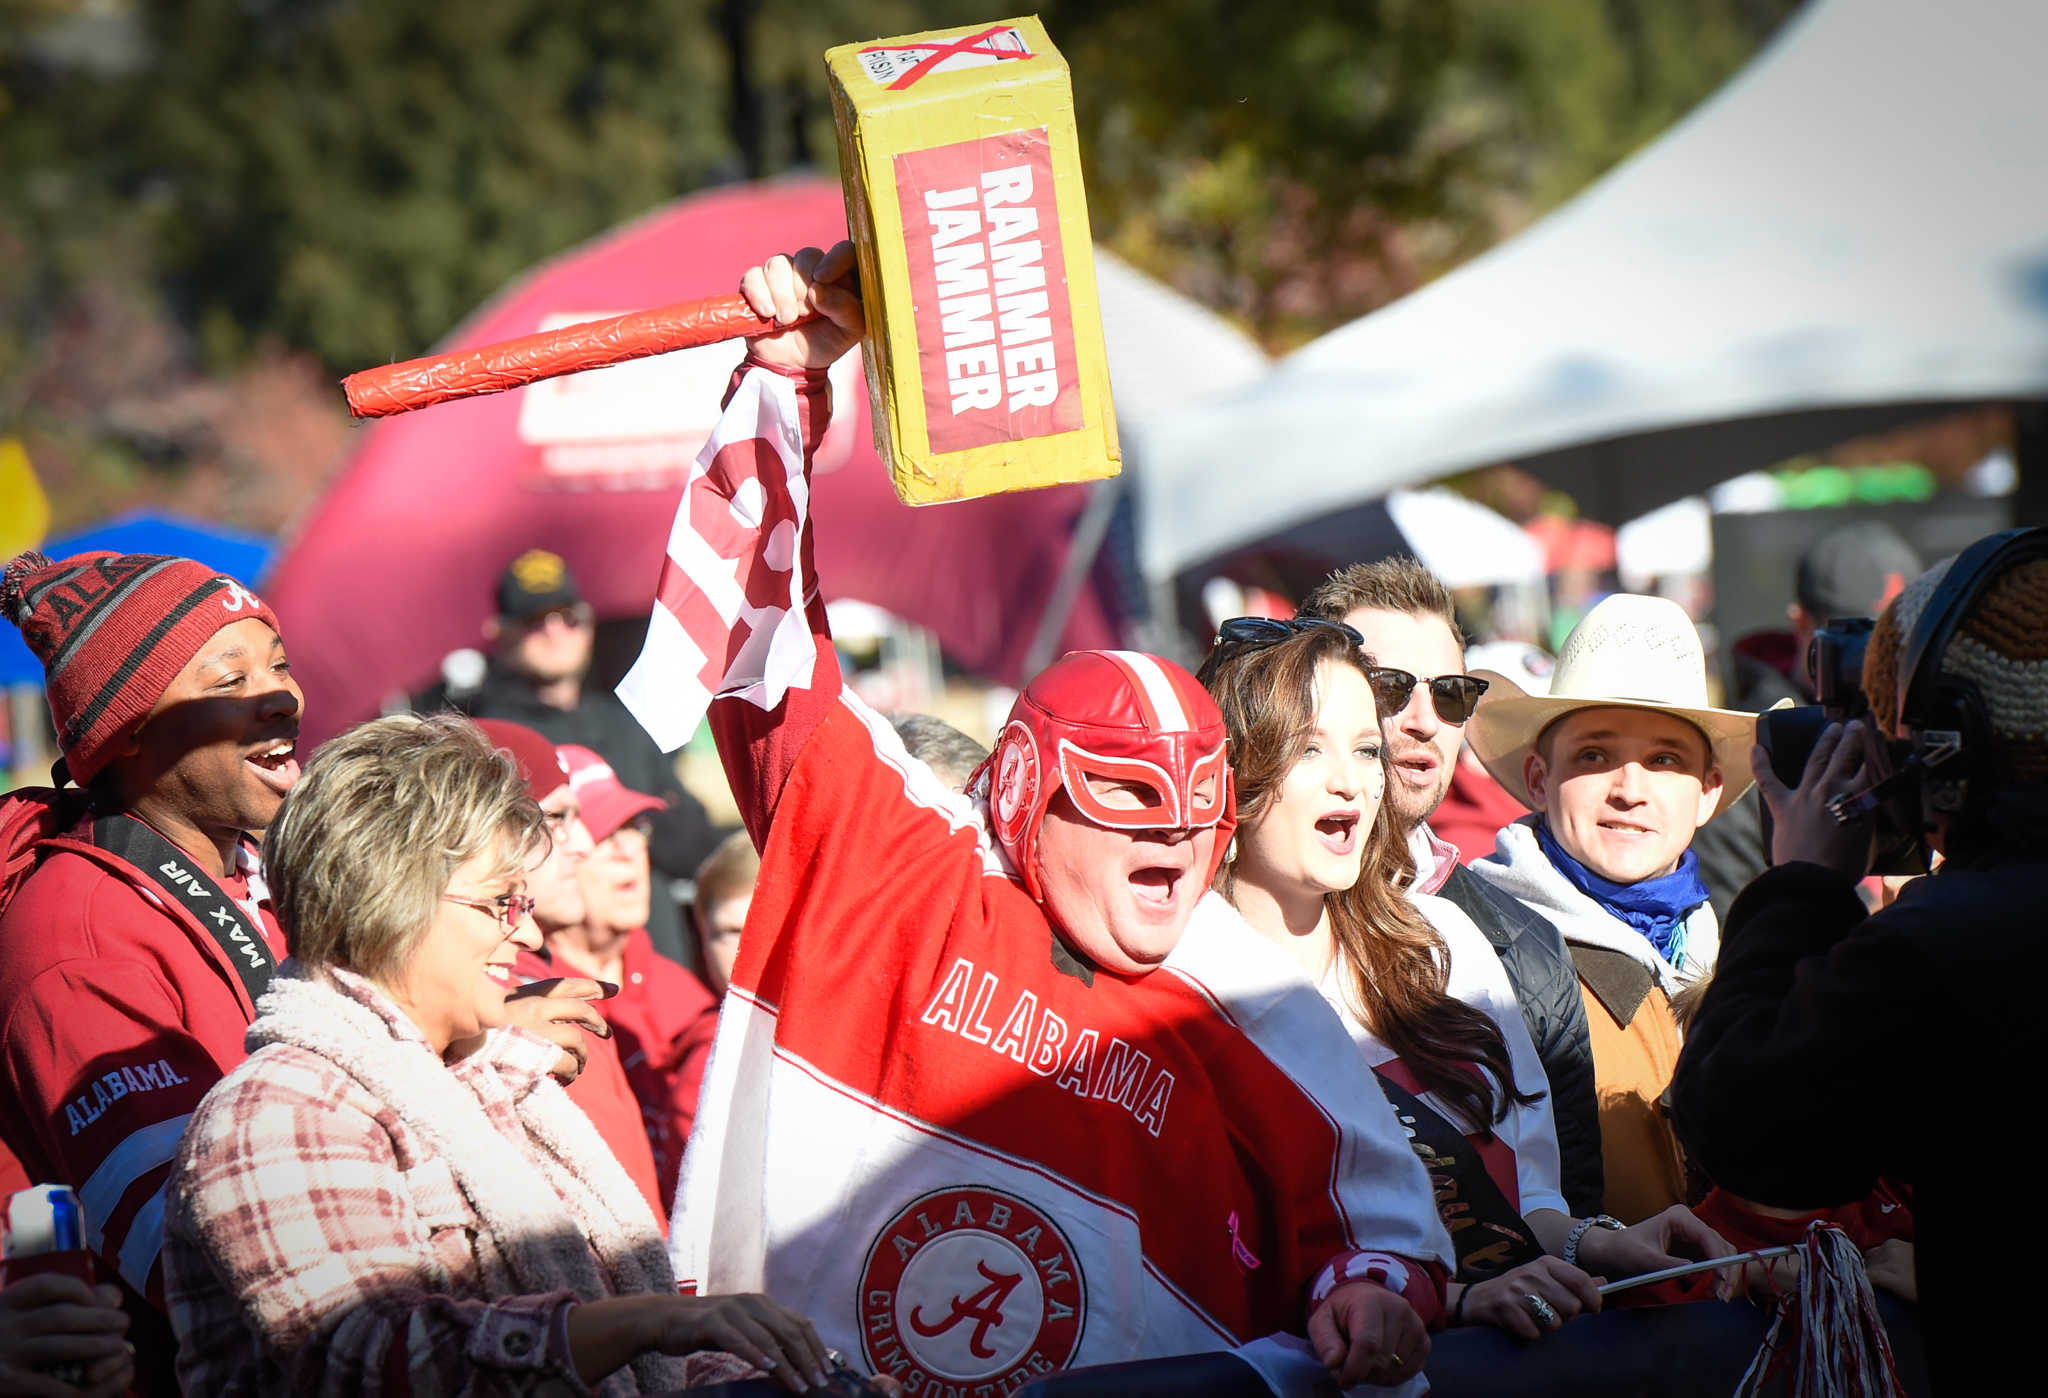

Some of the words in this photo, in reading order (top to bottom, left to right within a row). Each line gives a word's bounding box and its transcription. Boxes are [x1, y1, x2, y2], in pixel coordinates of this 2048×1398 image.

[924, 186, 1003, 416] JAMMER
[981, 164, 1059, 413] RAMMER
[159, 860, 212, 897] AIR
[208, 905, 266, 969] MAX
[64, 1059, 184, 1136] ALABAMA
[921, 957, 1175, 1137] ALABAMA
[892, 1200, 1074, 1323] ALABAMA
[910, 1259, 1023, 1359] A
[869, 1290, 967, 1398] CRIMSON
